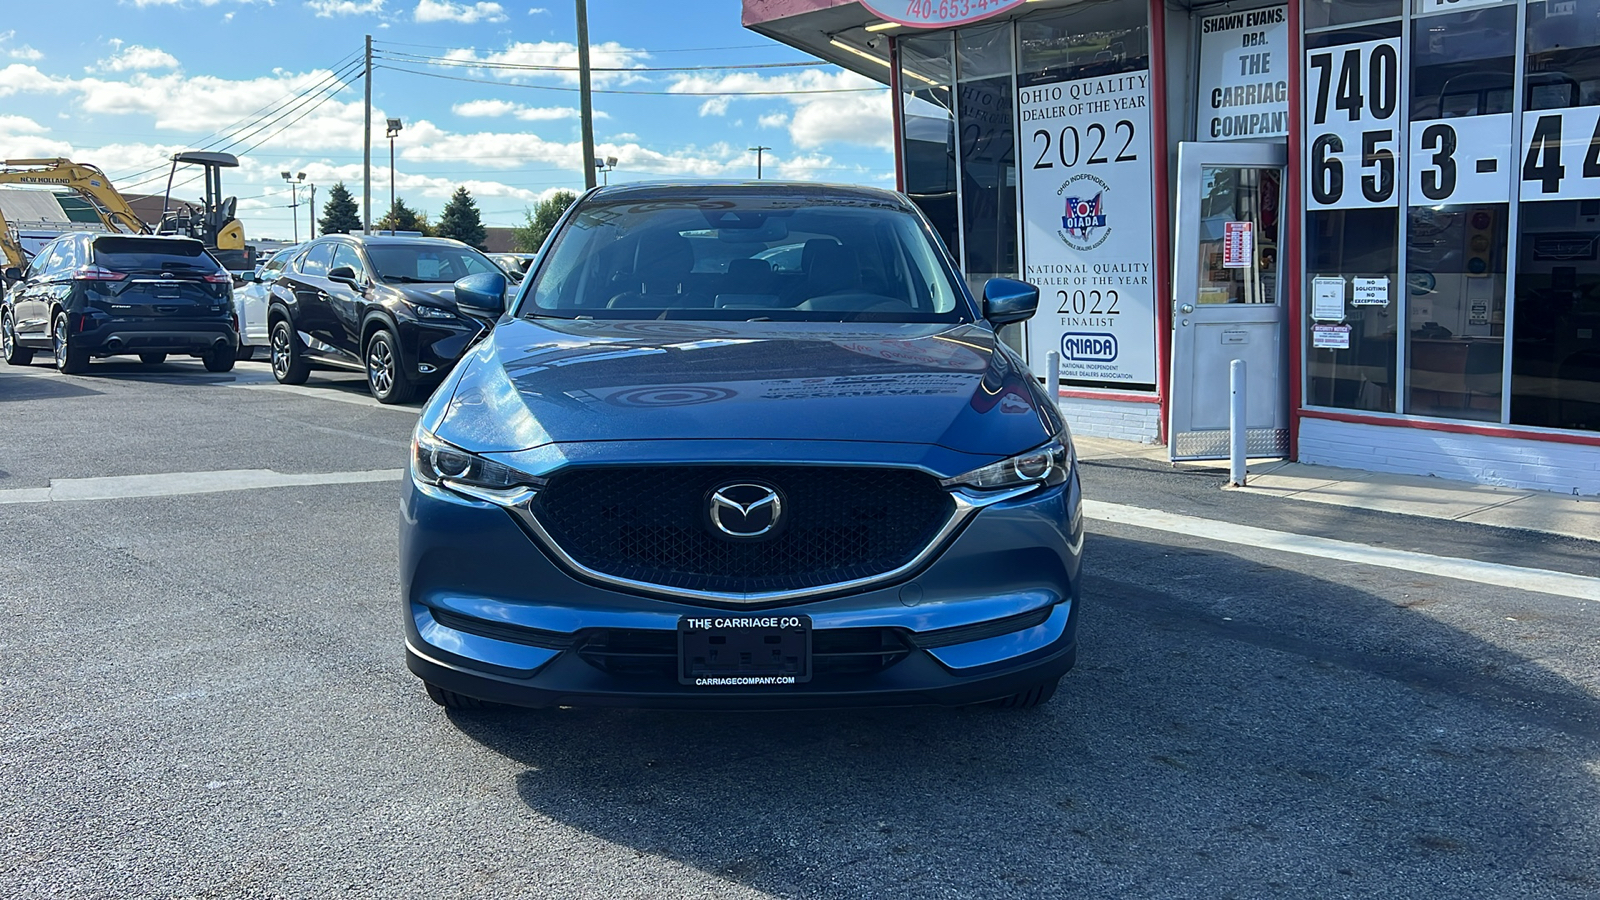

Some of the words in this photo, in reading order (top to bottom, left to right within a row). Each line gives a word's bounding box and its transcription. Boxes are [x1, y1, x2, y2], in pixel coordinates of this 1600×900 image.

[906, 0, 1008, 19] 740-653-4
[1203, 13, 1243, 33] SHAWN
[1246, 8, 1285, 27] EVANS.
[1242, 31, 1268, 48] DBA.
[1239, 52, 1270, 76] THE
[1020, 87, 1062, 105] OHIO
[1069, 75, 1148, 100] QUALITY
[1211, 81, 1288, 109] CARRIAG
[1310, 43, 1397, 125] 740
[1023, 105, 1066, 121] DEALER
[1068, 103, 1084, 116] OF
[1086, 99, 1110, 114] THE
[1113, 95, 1146, 110] YEAR
[1033, 119, 1137, 170] 2022
[1057, 180, 1070, 196] OHIO
[1069, 173, 1111, 193] INDEPENDENT
[1067, 216, 1099, 228] OIADA
[1092, 227, 1112, 249] ASSOCIATION
[1027, 264, 1088, 274] NATIONAL
[1093, 263, 1150, 275] QUALITY
[1029, 276, 1069, 286] DEALER
[1073, 276, 1087, 285] OF
[1091, 276, 1114, 285] THE
[1118, 276, 1148, 285] YEAR
[1056, 289, 1120, 315] 2022
[1061, 317, 1115, 327] FINALIST
[1065, 338, 1112, 356] NIADA
[687, 618, 712, 629] THE
[714, 617, 778, 628] CARRIAGE
[780, 617, 801, 627] CO.
[695, 676, 795, 686] CARRIAGECOMPANY.COM
